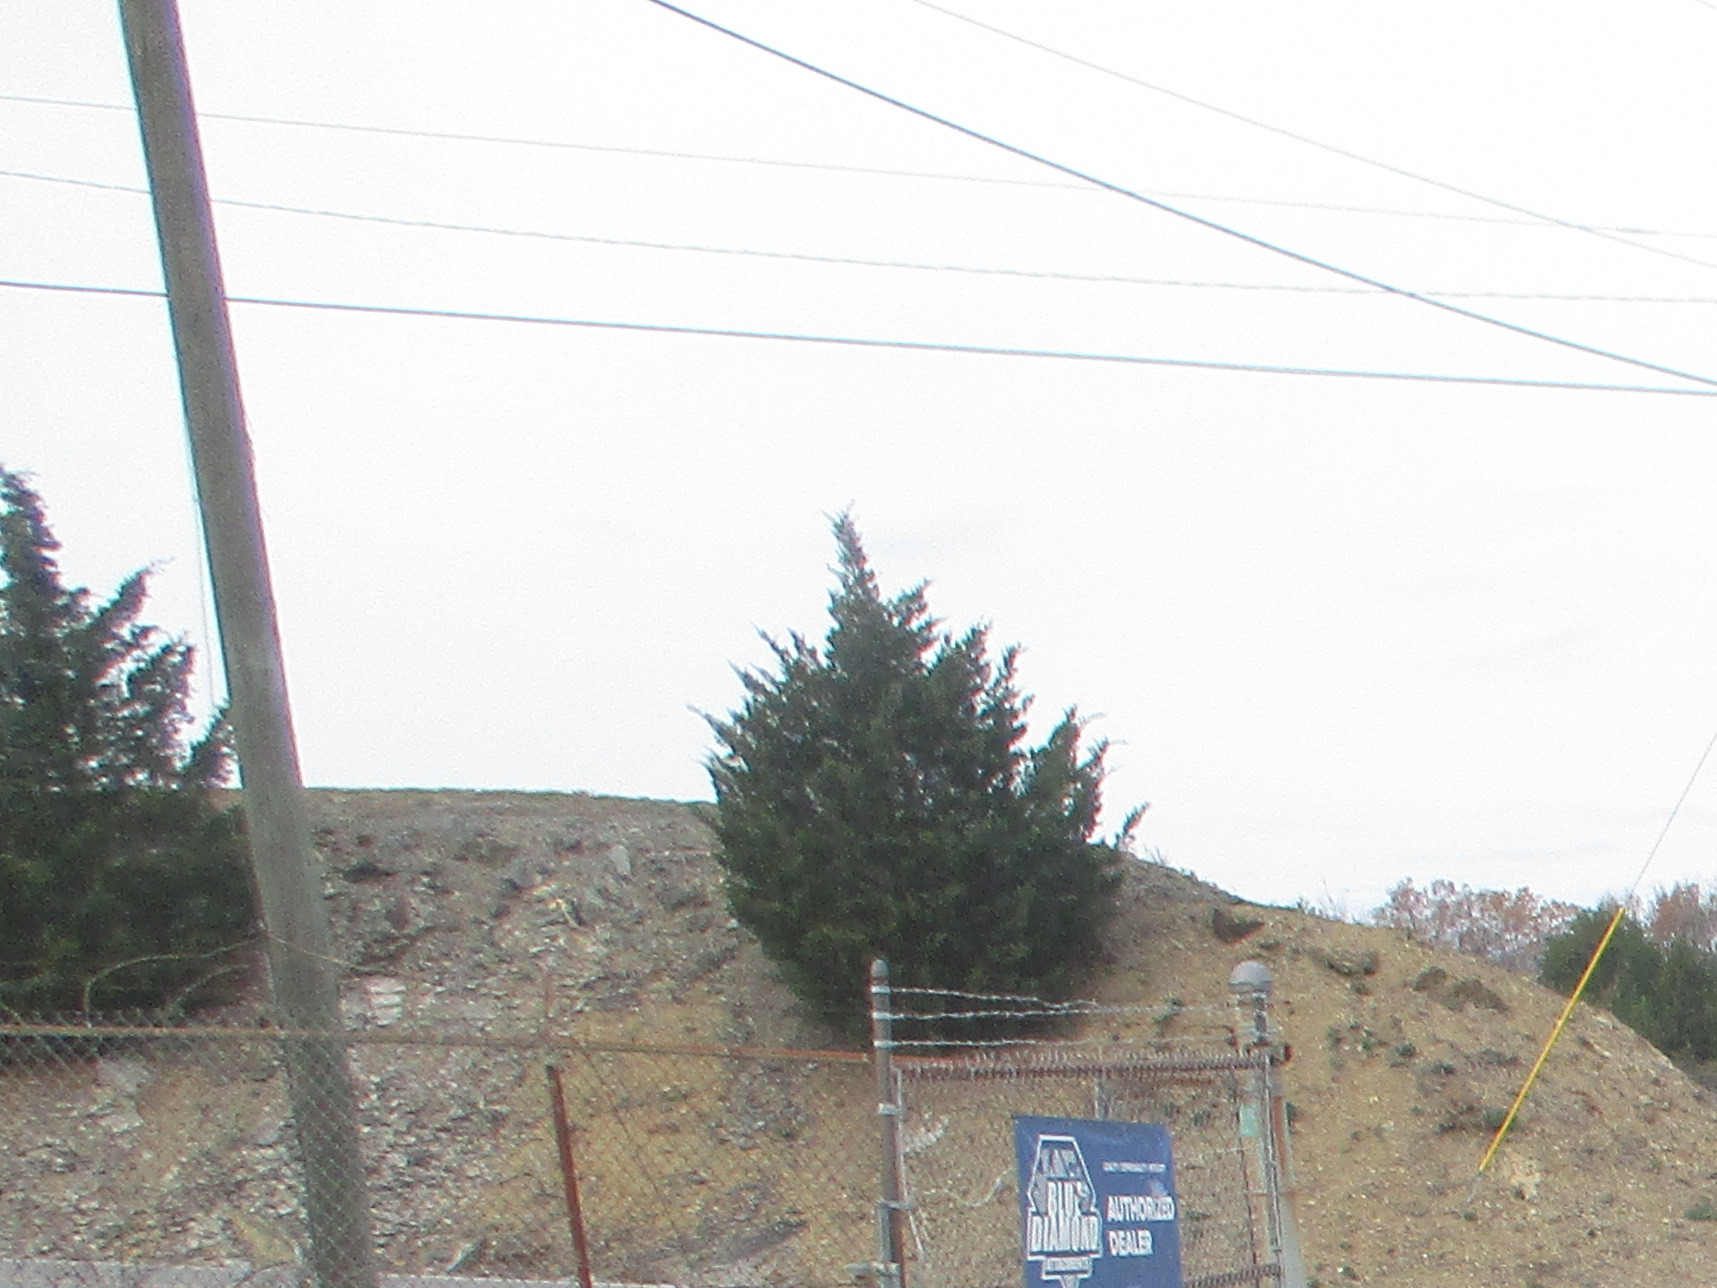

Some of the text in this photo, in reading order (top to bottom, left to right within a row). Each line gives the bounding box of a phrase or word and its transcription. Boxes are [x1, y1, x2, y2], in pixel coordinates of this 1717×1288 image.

[1107, 1196, 1175, 1221] AUTHORIZED
[1032, 1216, 1099, 1252] DIAMOND
[1108, 1229, 1153, 1256] DEALER
